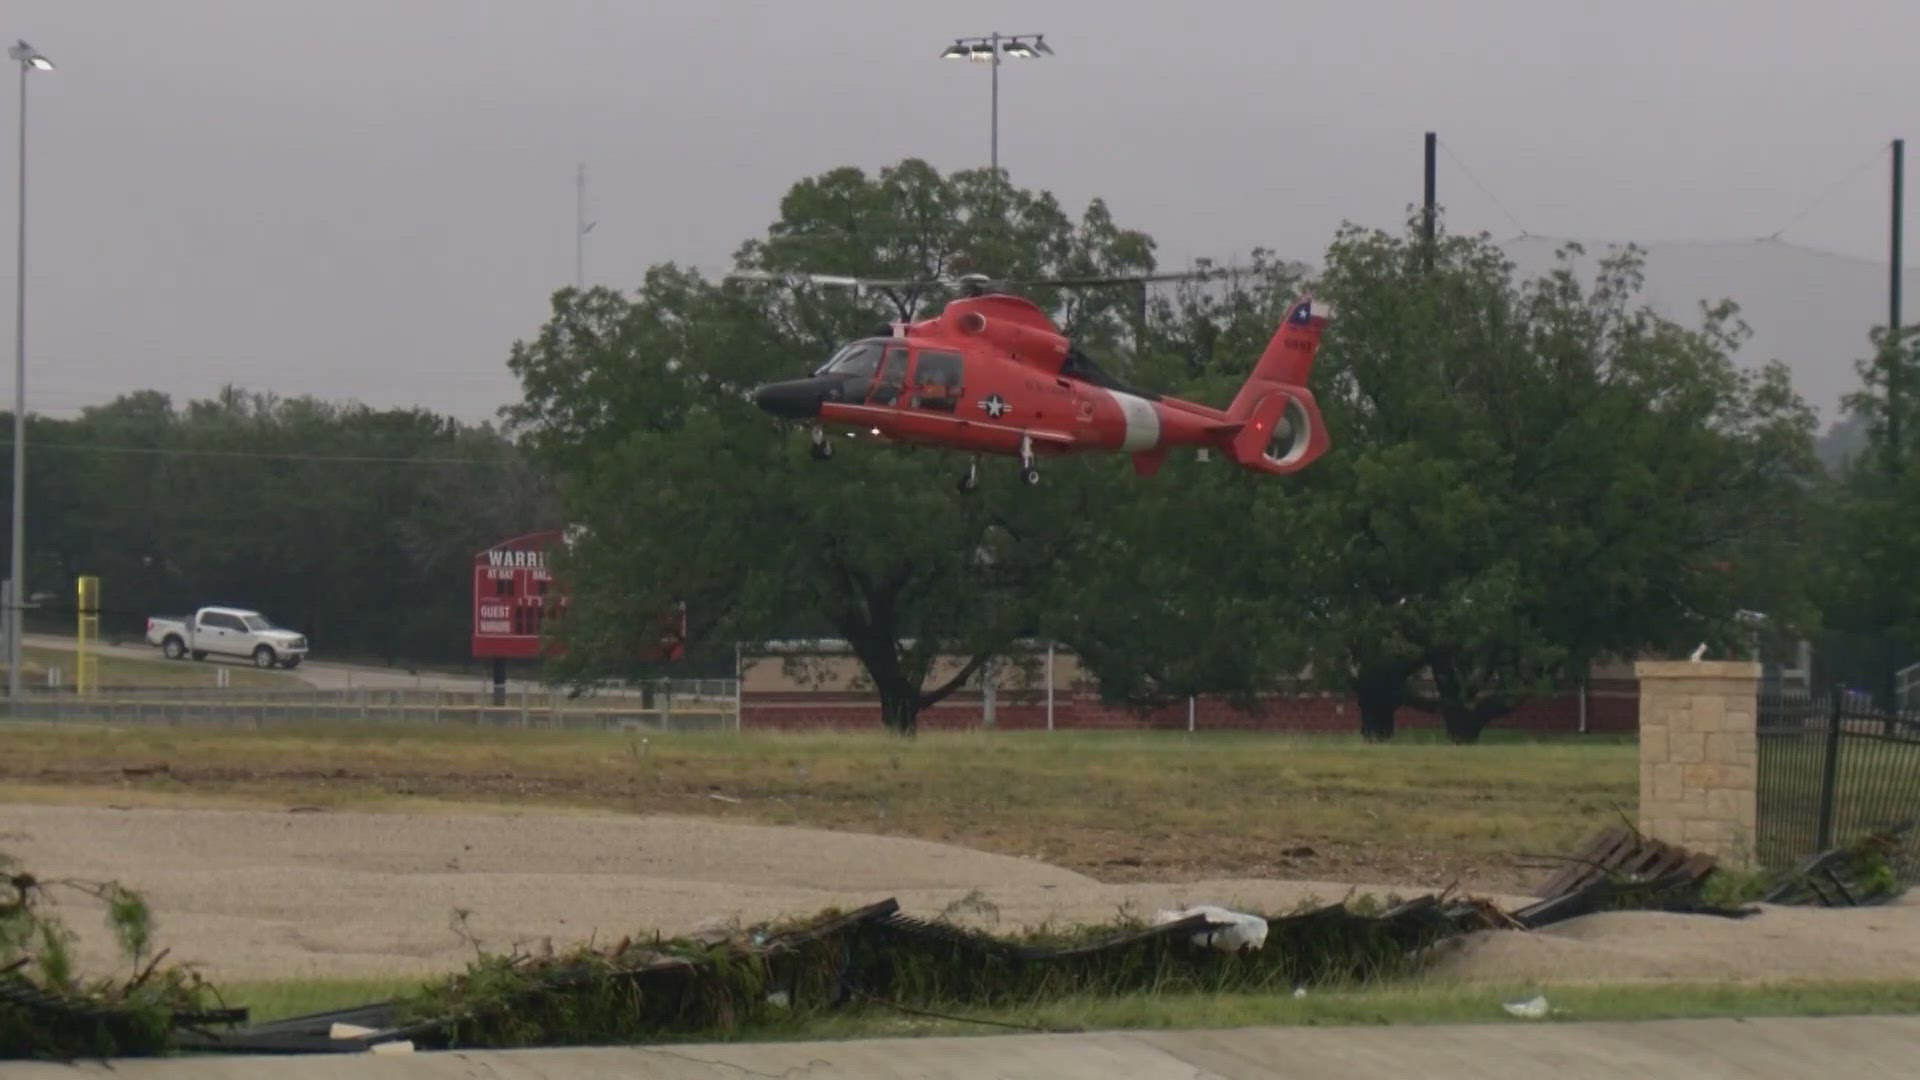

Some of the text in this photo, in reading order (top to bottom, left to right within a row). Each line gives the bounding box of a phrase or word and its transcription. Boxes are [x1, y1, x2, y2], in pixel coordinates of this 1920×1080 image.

[489, 551, 547, 567] WARRI
[487, 569, 497, 579] AT
[480, 606, 510, 618] GUEST
